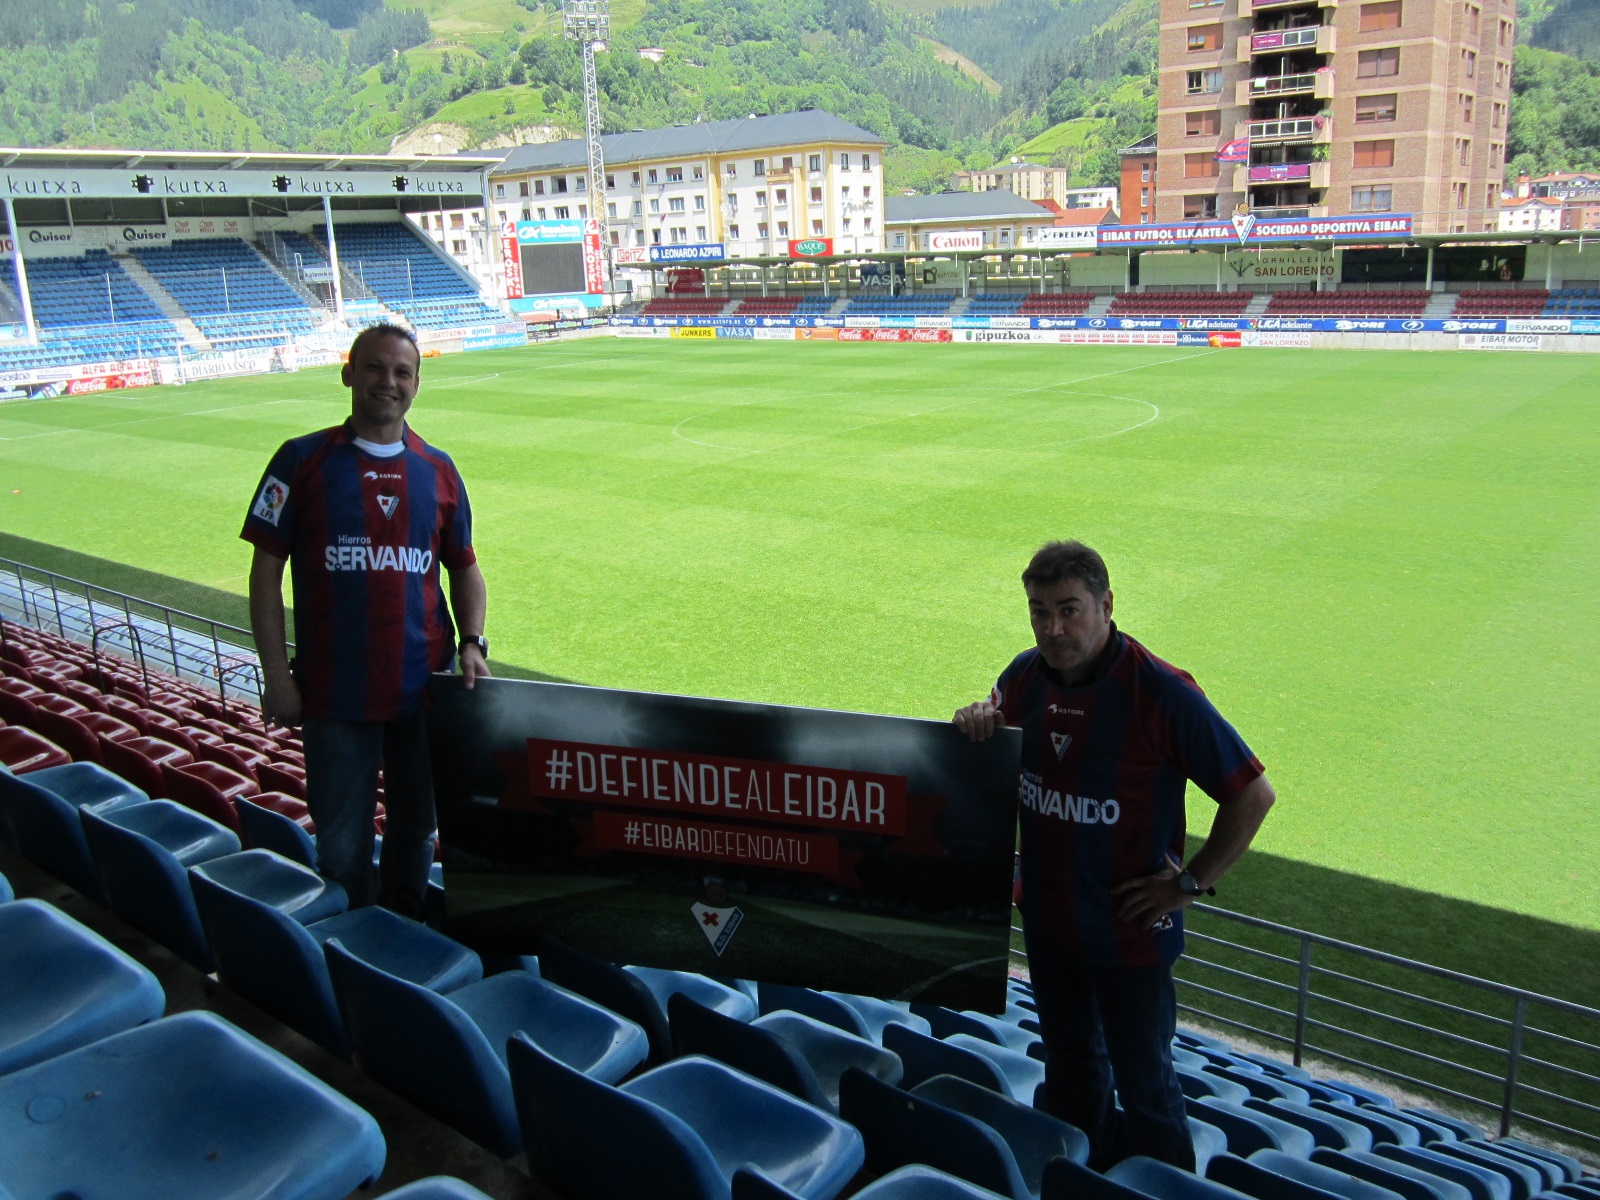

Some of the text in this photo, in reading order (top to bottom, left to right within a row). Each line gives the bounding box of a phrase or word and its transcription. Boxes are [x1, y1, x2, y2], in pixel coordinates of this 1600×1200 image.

[7, 174, 82, 194] kutxa
[164, 175, 228, 194] kutxa
[300, 176, 355, 193] kutxa
[416, 176, 464, 192] kutxa
[1256, 223, 1308, 236] SOCIEDAD
[1310, 221, 1371, 234] DEPORTIVA
[1374, 219, 1406, 231] EIBAR
[29, 230, 72, 243] Quiser
[123, 228, 167, 241] Quiser
[1102, 230, 1131, 242] EIBAR
[1134, 229, 1173, 241] FUTBOL
[1176, 227, 1229, 239] ELKARTEA
[932, 235, 980, 248] Canon
[661, 246, 722, 259] LEONARDO AZPIRI
[503, 239, 515, 296] EROSKI
[585, 235, 597, 292] EROSKI
[1254, 265, 1334, 277] SAN LORENZO
[861, 274, 903, 286] VASA
[1186, 319, 1209, 328] LIGA
[1257, 319, 1313, 329] LIGA adelante
[724, 327, 753, 337] VASA
[975, 329, 1031, 342] gipuzkoa
[1481, 335, 1539, 345] EIBAR MOTOR
[192, 362, 226, 376] DIARIO
[227, 359, 256, 372] VASCO
[379, 472, 402, 480] ASTORE
[338, 535, 371, 545] Hierros
[325, 545, 432, 574] SERVANDO
[1058, 707, 1085, 716] ASTORE
[545, 748, 886, 826] #DEFIENDEALEIBAR
[624, 821, 809, 865] #EIBARDEFENDATU
[726, 913, 741, 935] EIBAR
